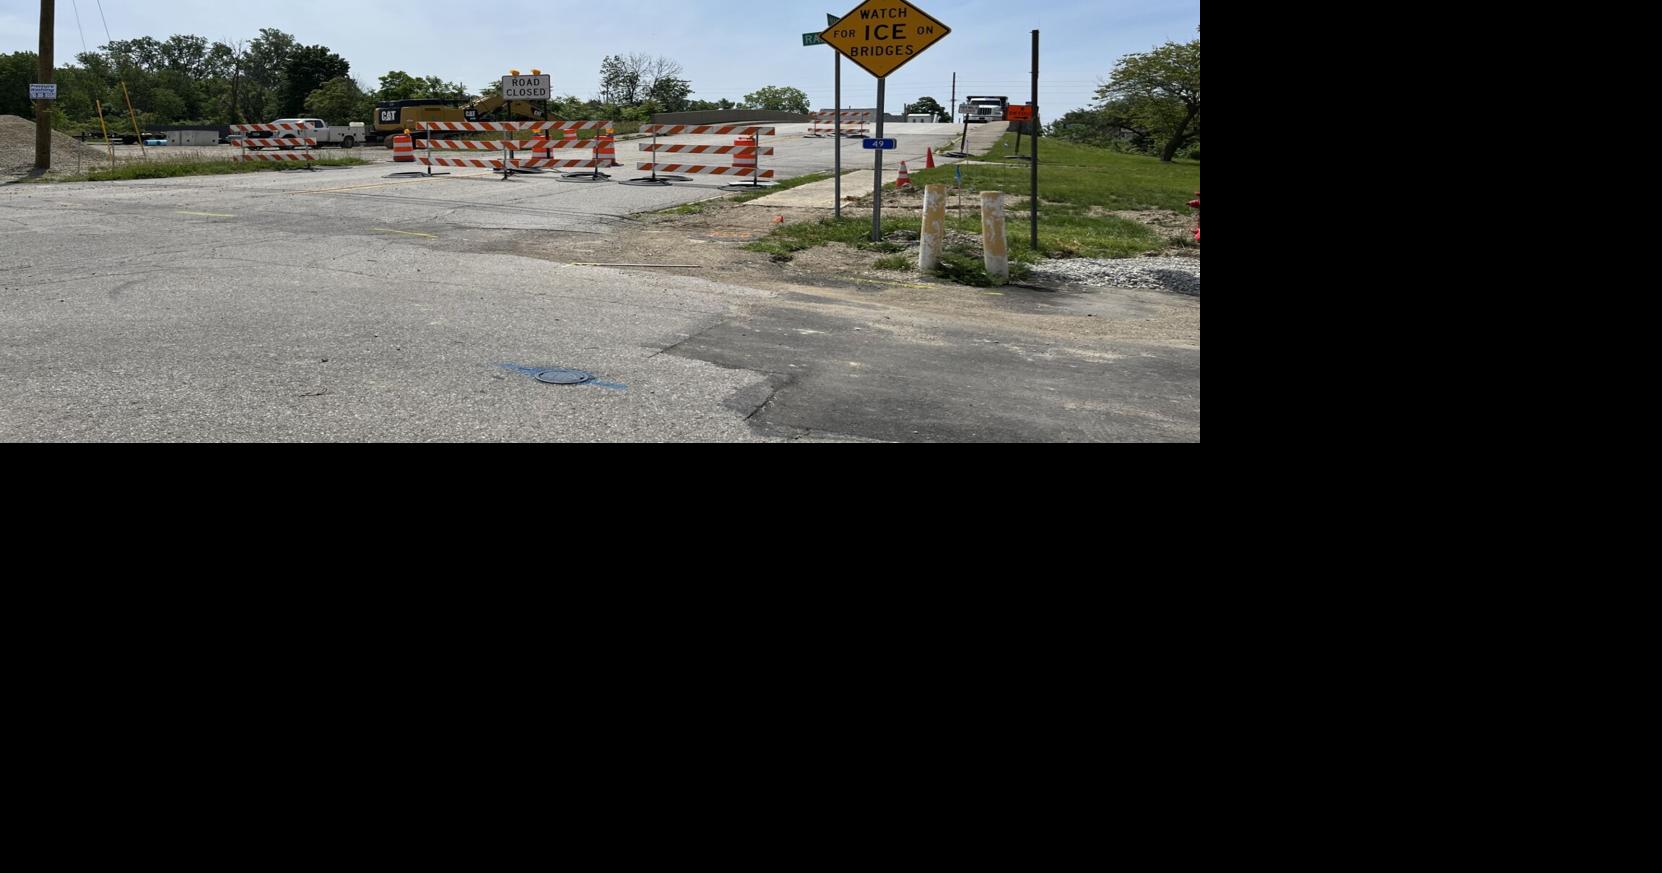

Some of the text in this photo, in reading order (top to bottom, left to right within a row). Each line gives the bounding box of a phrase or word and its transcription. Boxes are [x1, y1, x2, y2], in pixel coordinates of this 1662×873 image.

[860, 8, 907, 19] WATCH
[833, 23, 934, 41] FOR ICE ON
[850, 45, 914, 57] BRIDGES
[512, 78, 540, 87] ROAD
[506, 88, 546, 97] CLOSED
[381, 110, 397, 121] CAT
[872, 140, 885, 148] 49
